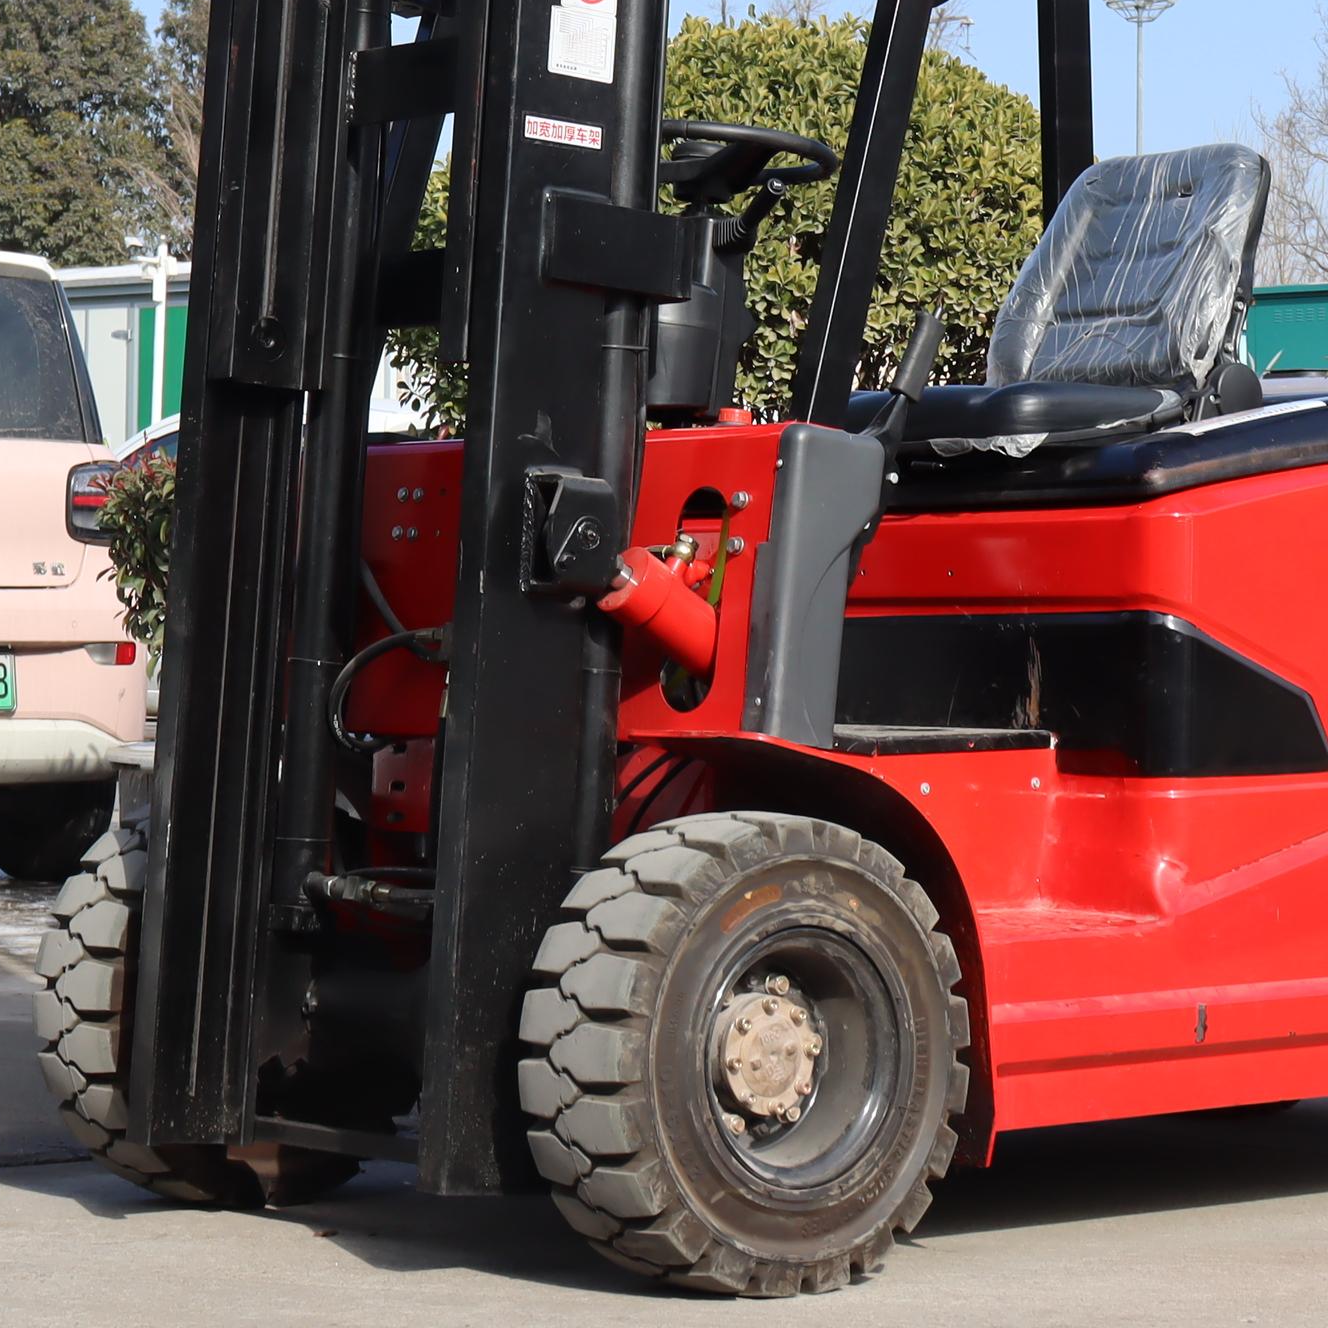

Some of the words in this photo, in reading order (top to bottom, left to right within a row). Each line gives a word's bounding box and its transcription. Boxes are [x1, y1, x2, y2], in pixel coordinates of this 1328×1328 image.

[526, 118, 601, 147] 加宽加厚车架
